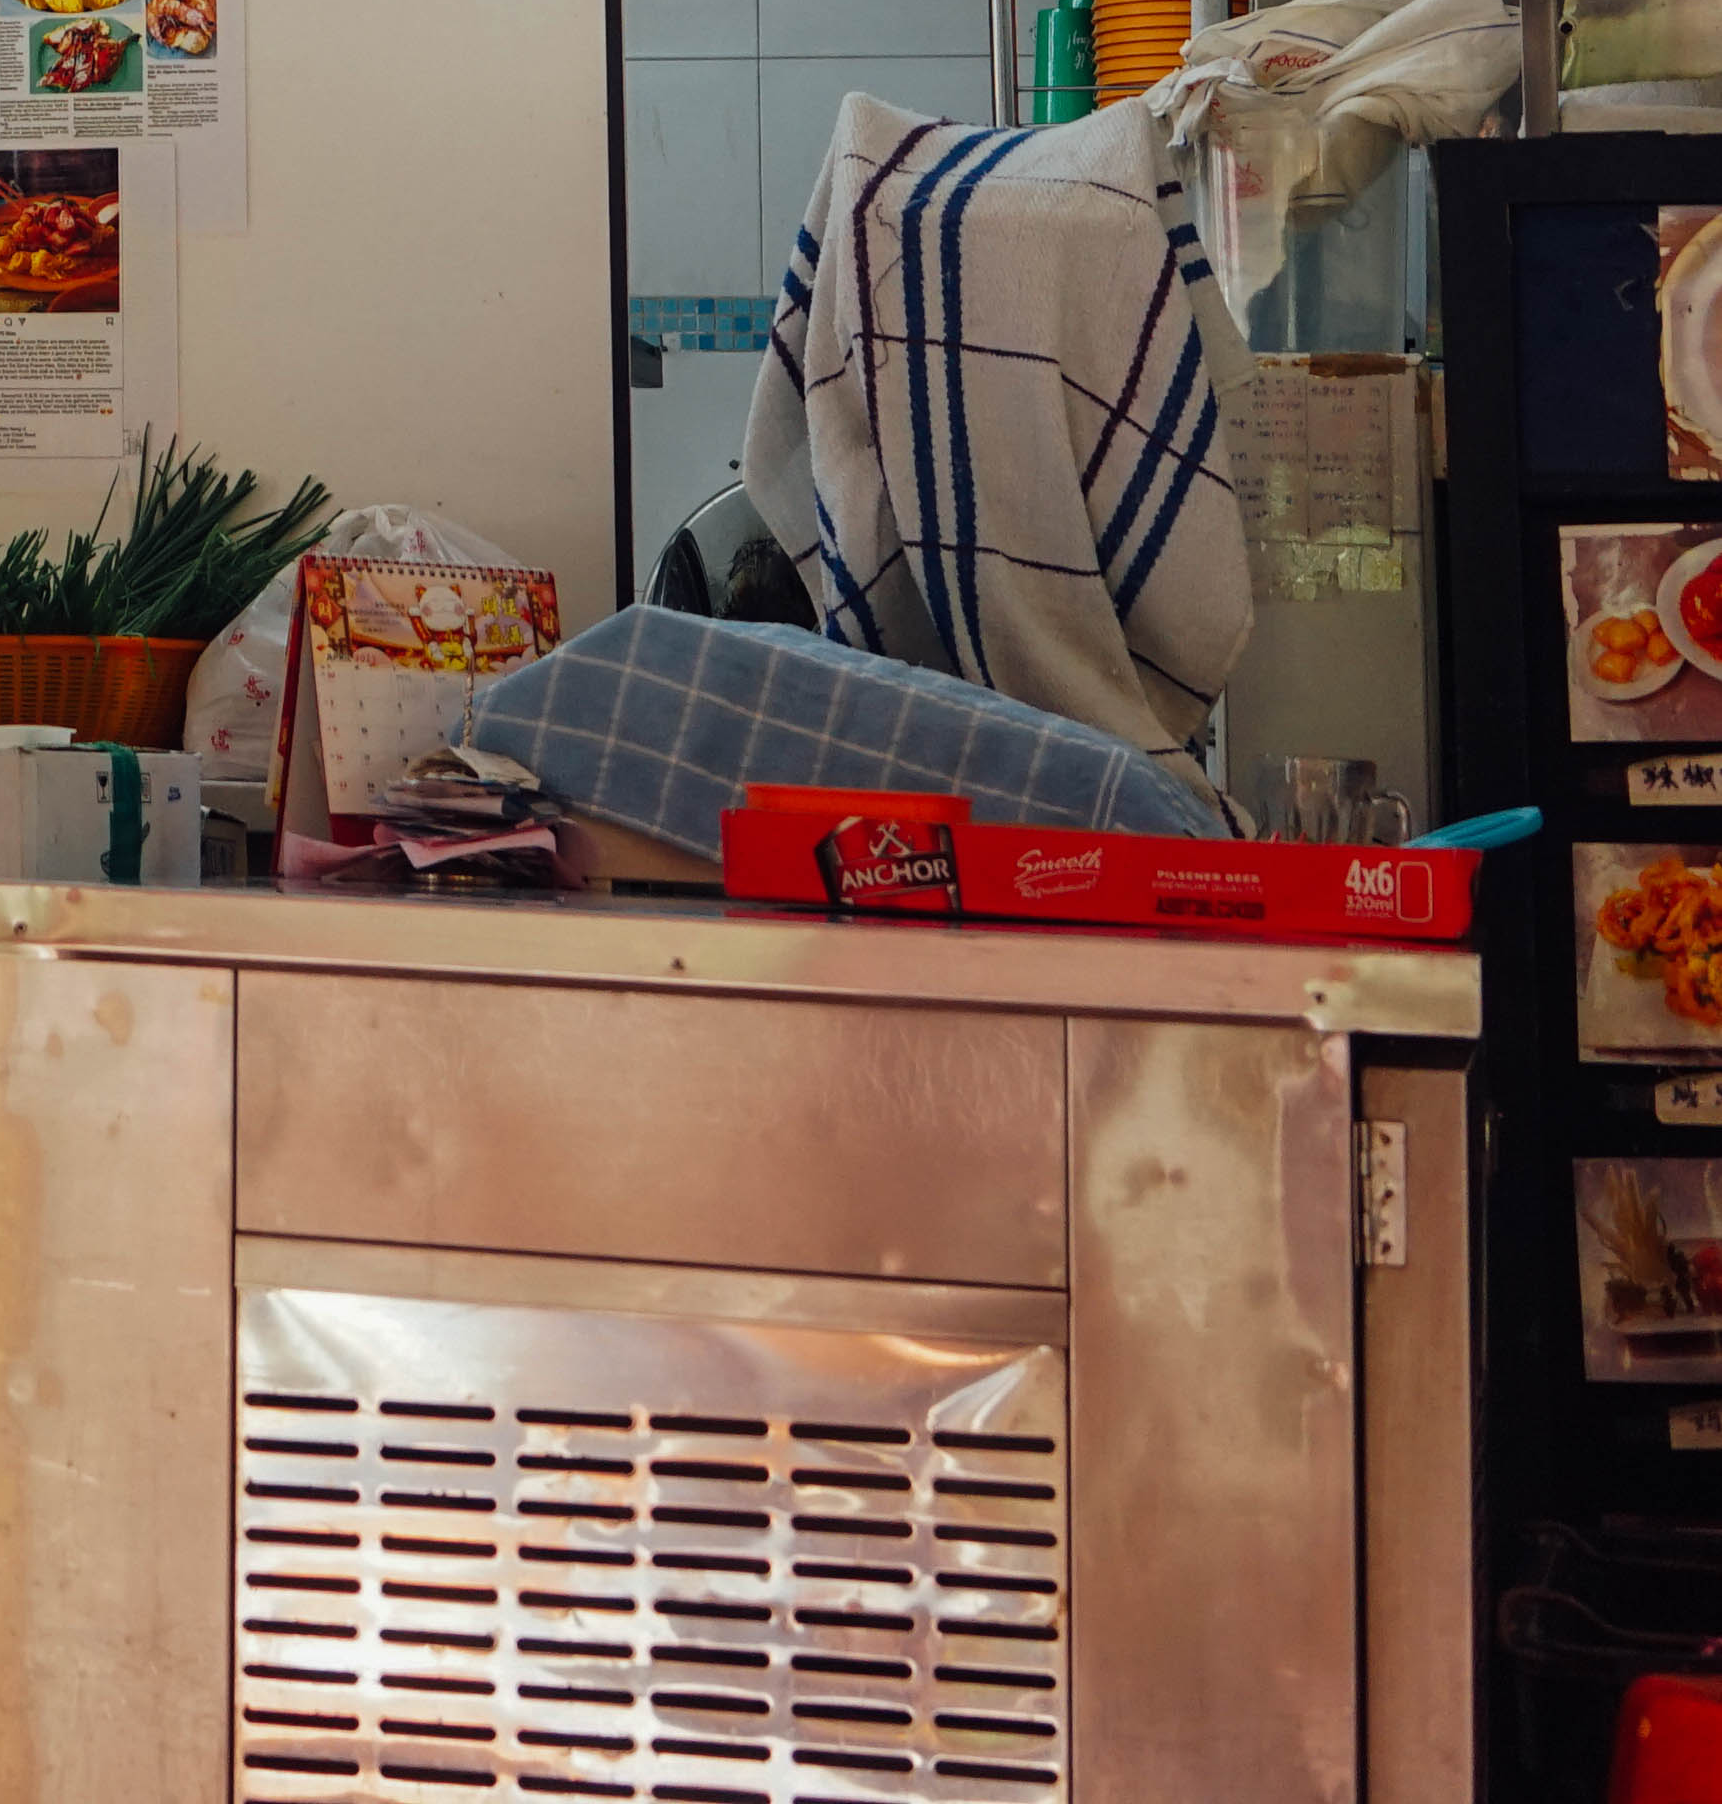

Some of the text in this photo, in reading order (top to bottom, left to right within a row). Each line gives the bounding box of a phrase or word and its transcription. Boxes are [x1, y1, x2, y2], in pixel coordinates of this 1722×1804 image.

[842, 858, 950, 891] ANCHOR
[1157, 870, 1260, 883] PILSENER BEER
[1345, 859, 1394, 896] 4x6
